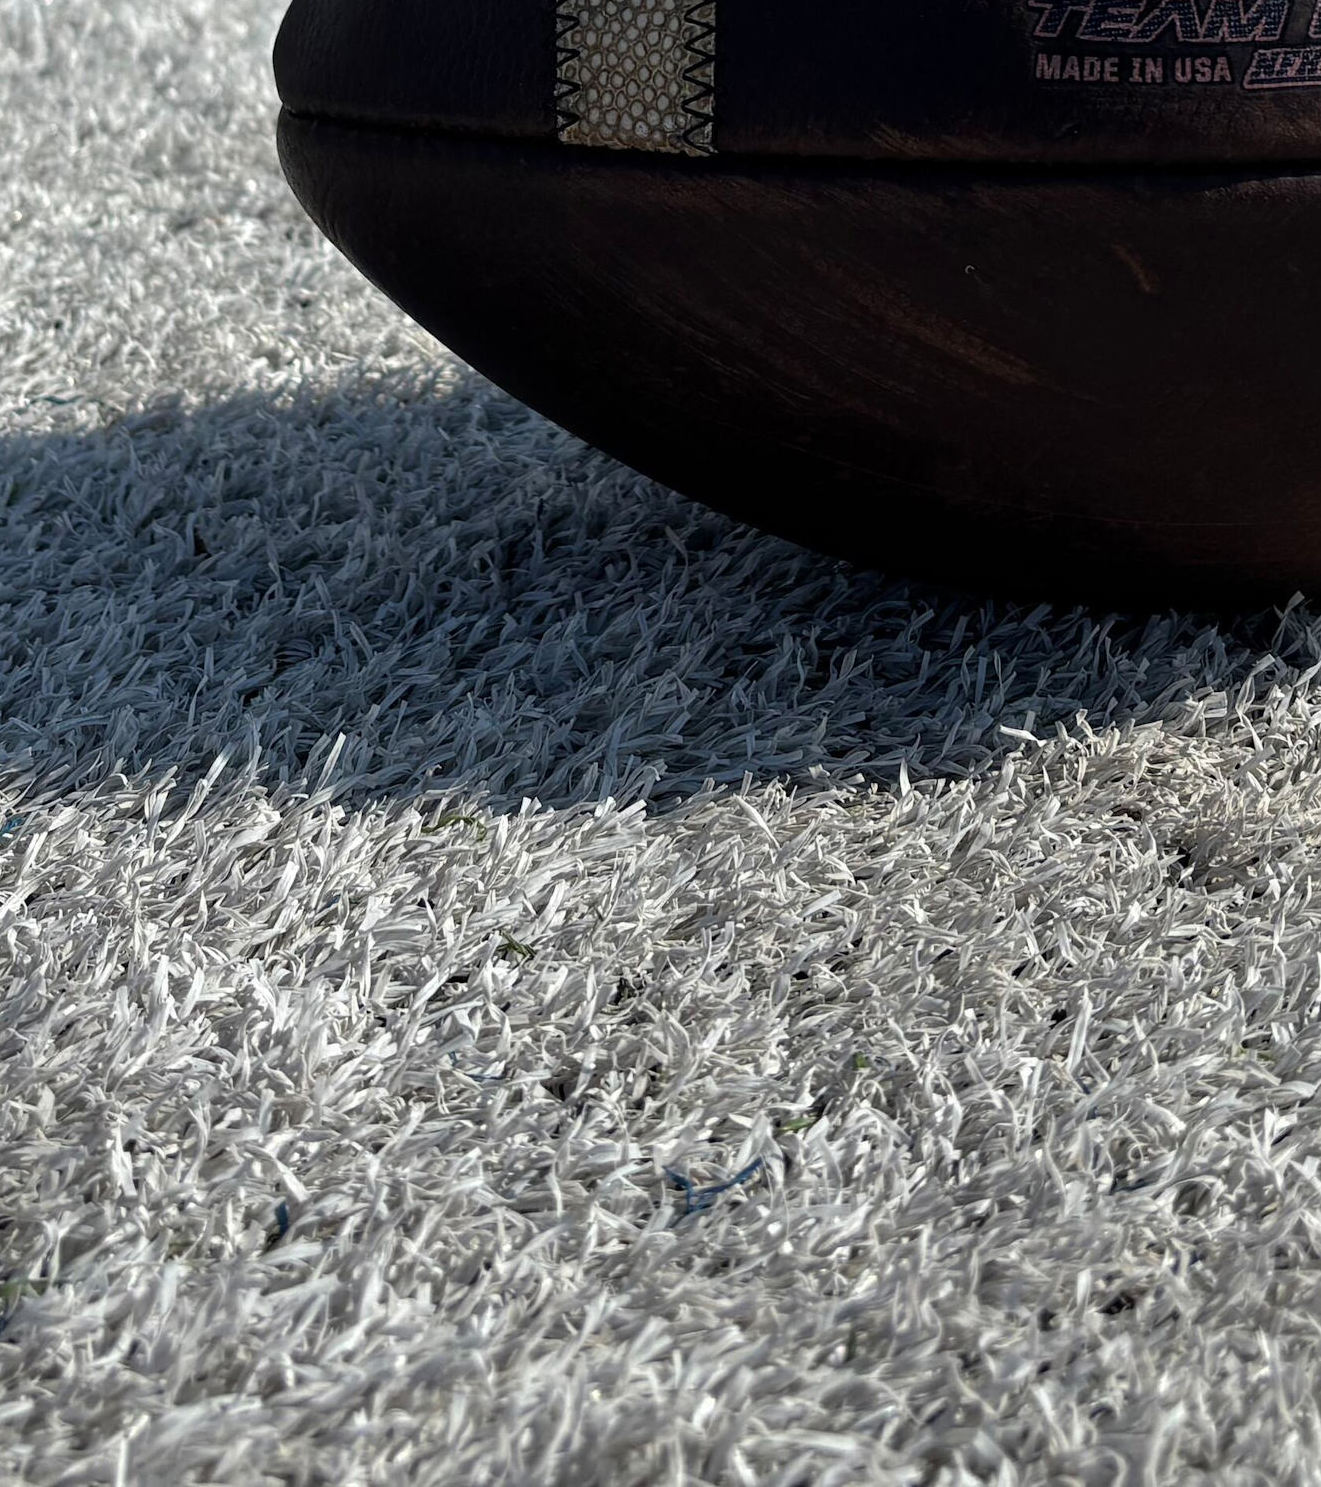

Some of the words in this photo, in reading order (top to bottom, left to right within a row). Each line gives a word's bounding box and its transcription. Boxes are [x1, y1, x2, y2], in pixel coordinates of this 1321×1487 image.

[1035, 53, 1119, 82] MADE
[1128, 57, 1164, 83] IN
[1175, 57, 1232, 83] USA
